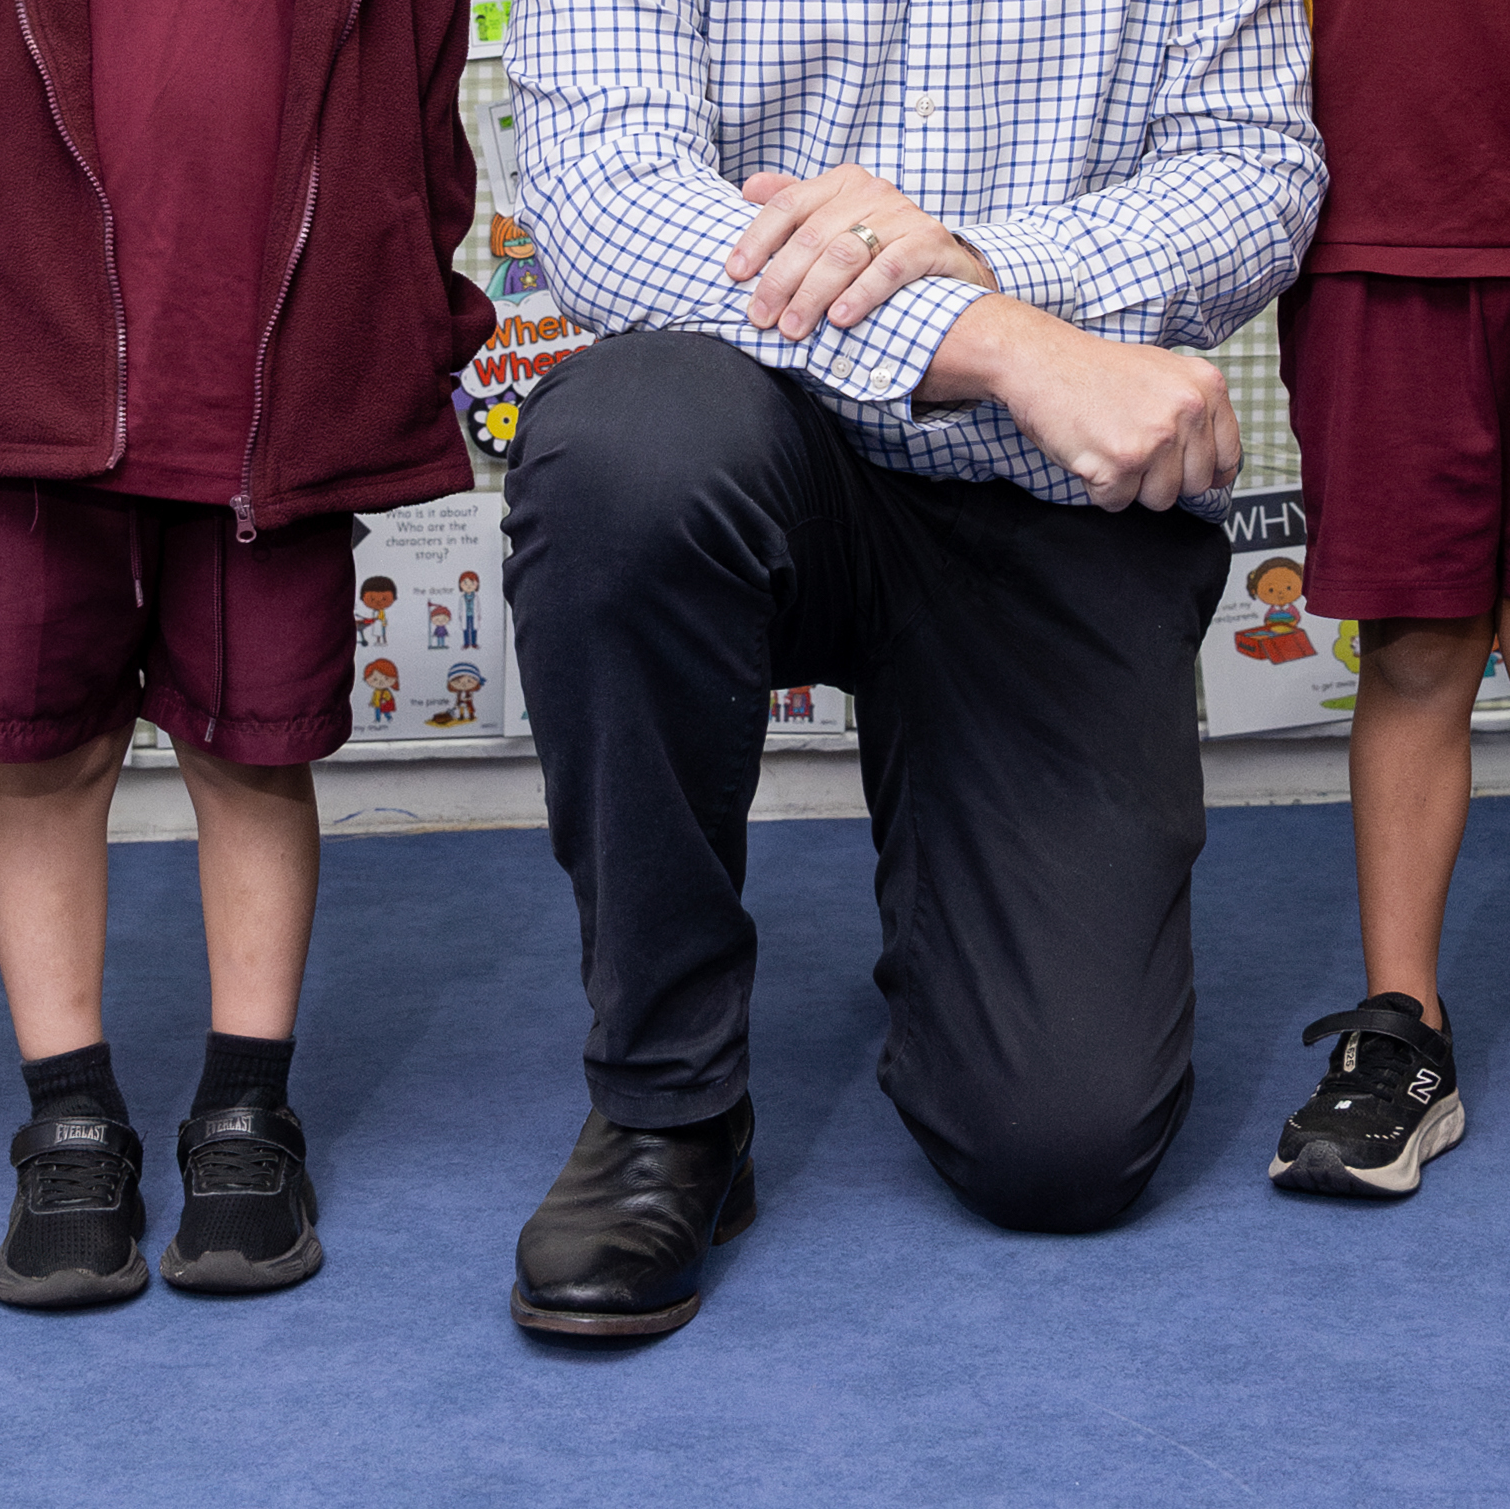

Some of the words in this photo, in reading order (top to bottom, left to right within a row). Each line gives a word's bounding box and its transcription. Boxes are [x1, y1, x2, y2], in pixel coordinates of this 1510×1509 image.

[397, 522, 422, 533] Who
[428, 524, 445, 533] are
[450, 520, 467, 531] the
[56, 1123, 108, 1145] EVERLAST
[205, 1114, 258, 1138] EVERLAST
